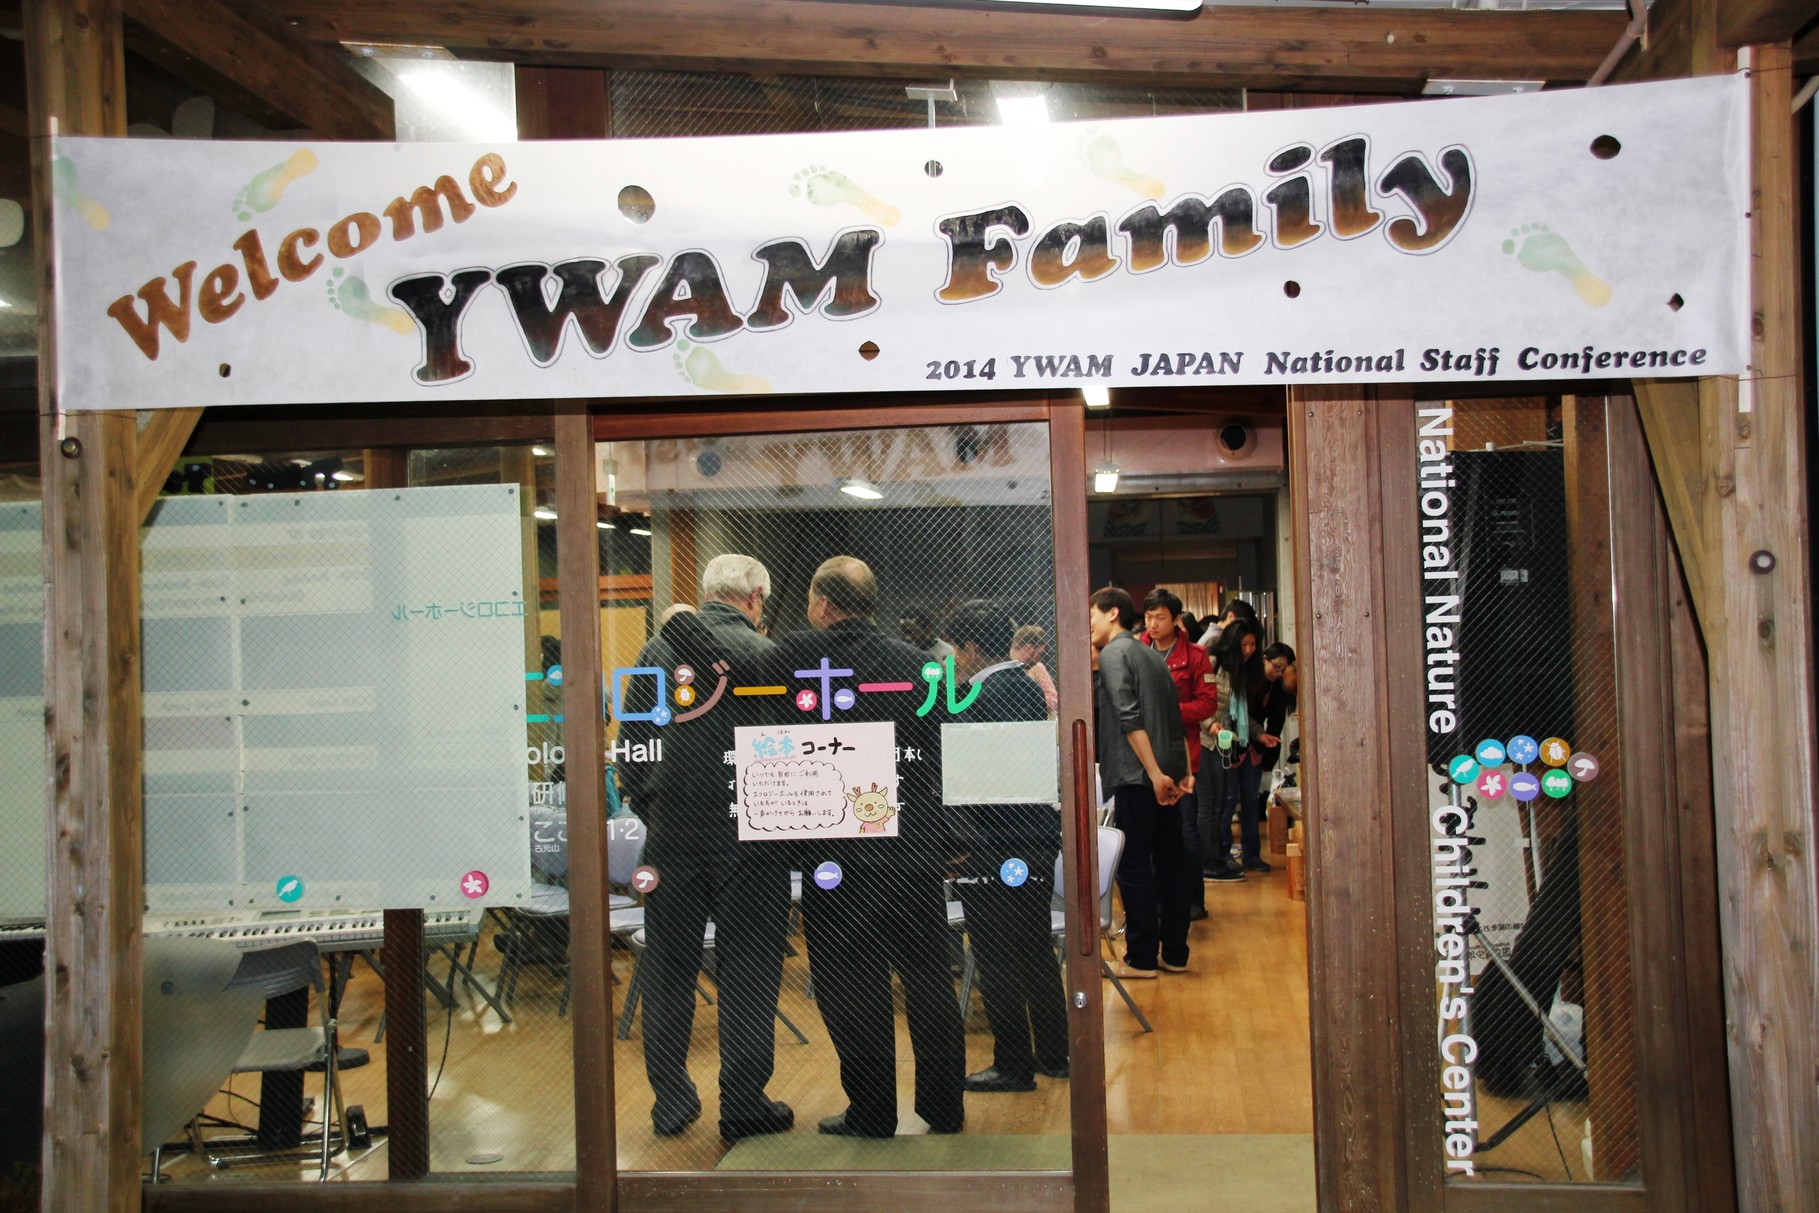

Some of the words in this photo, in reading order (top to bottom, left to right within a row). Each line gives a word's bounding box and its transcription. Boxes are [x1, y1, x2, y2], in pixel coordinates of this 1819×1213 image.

[107, 152, 518, 361] Welcome
[388, 226, 884, 387] YWAM
[934, 132, 1476, 305] Family
[925, 358, 997, 381] 2014
[1009, 354, 1114, 378] YWAM
[1131, 351, 1244, 376] JAPAN
[1264, 348, 1405, 375] National
[1419, 347, 1500, 377] Staff
[1516, 346, 1707, 374] Conference
[1418, 408, 1459, 580] National
[1425, 594, 1461, 735] Nature
[610, 738, 663, 763] Hall
[1432, 804, 1475, 1020] Children's
[1441, 1033, 1478, 1177] Center
